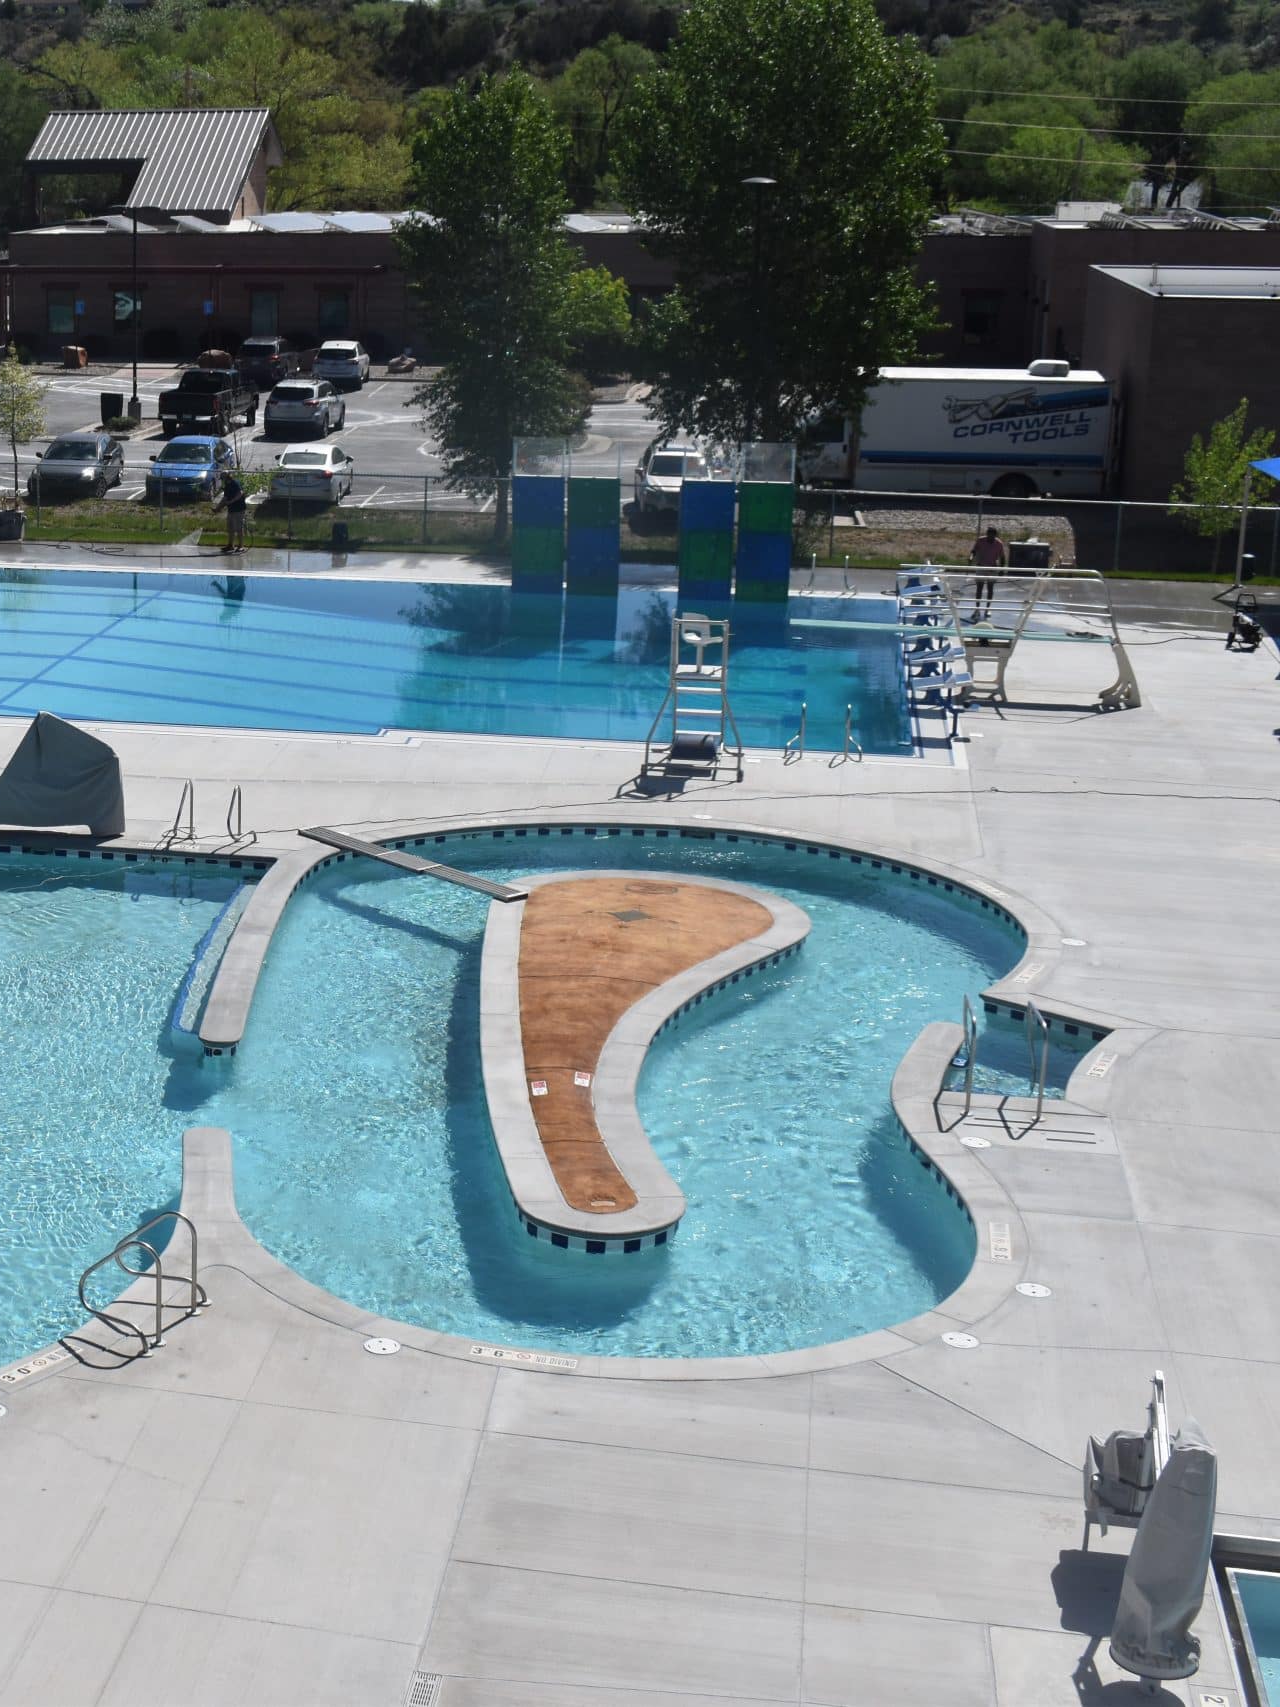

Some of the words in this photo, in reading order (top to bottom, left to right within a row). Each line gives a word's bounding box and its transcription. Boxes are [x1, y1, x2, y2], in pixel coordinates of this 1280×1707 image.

[953, 411, 1091, 438] CORNWELL
[1008, 424, 1089, 444] TOOLS
[472, 1347, 483, 1355] 3
[493, 1350, 504, 1358] 6
[549, 1357, 577, 1368] DIVING
[1203, 1695, 1225, 1704] 2
